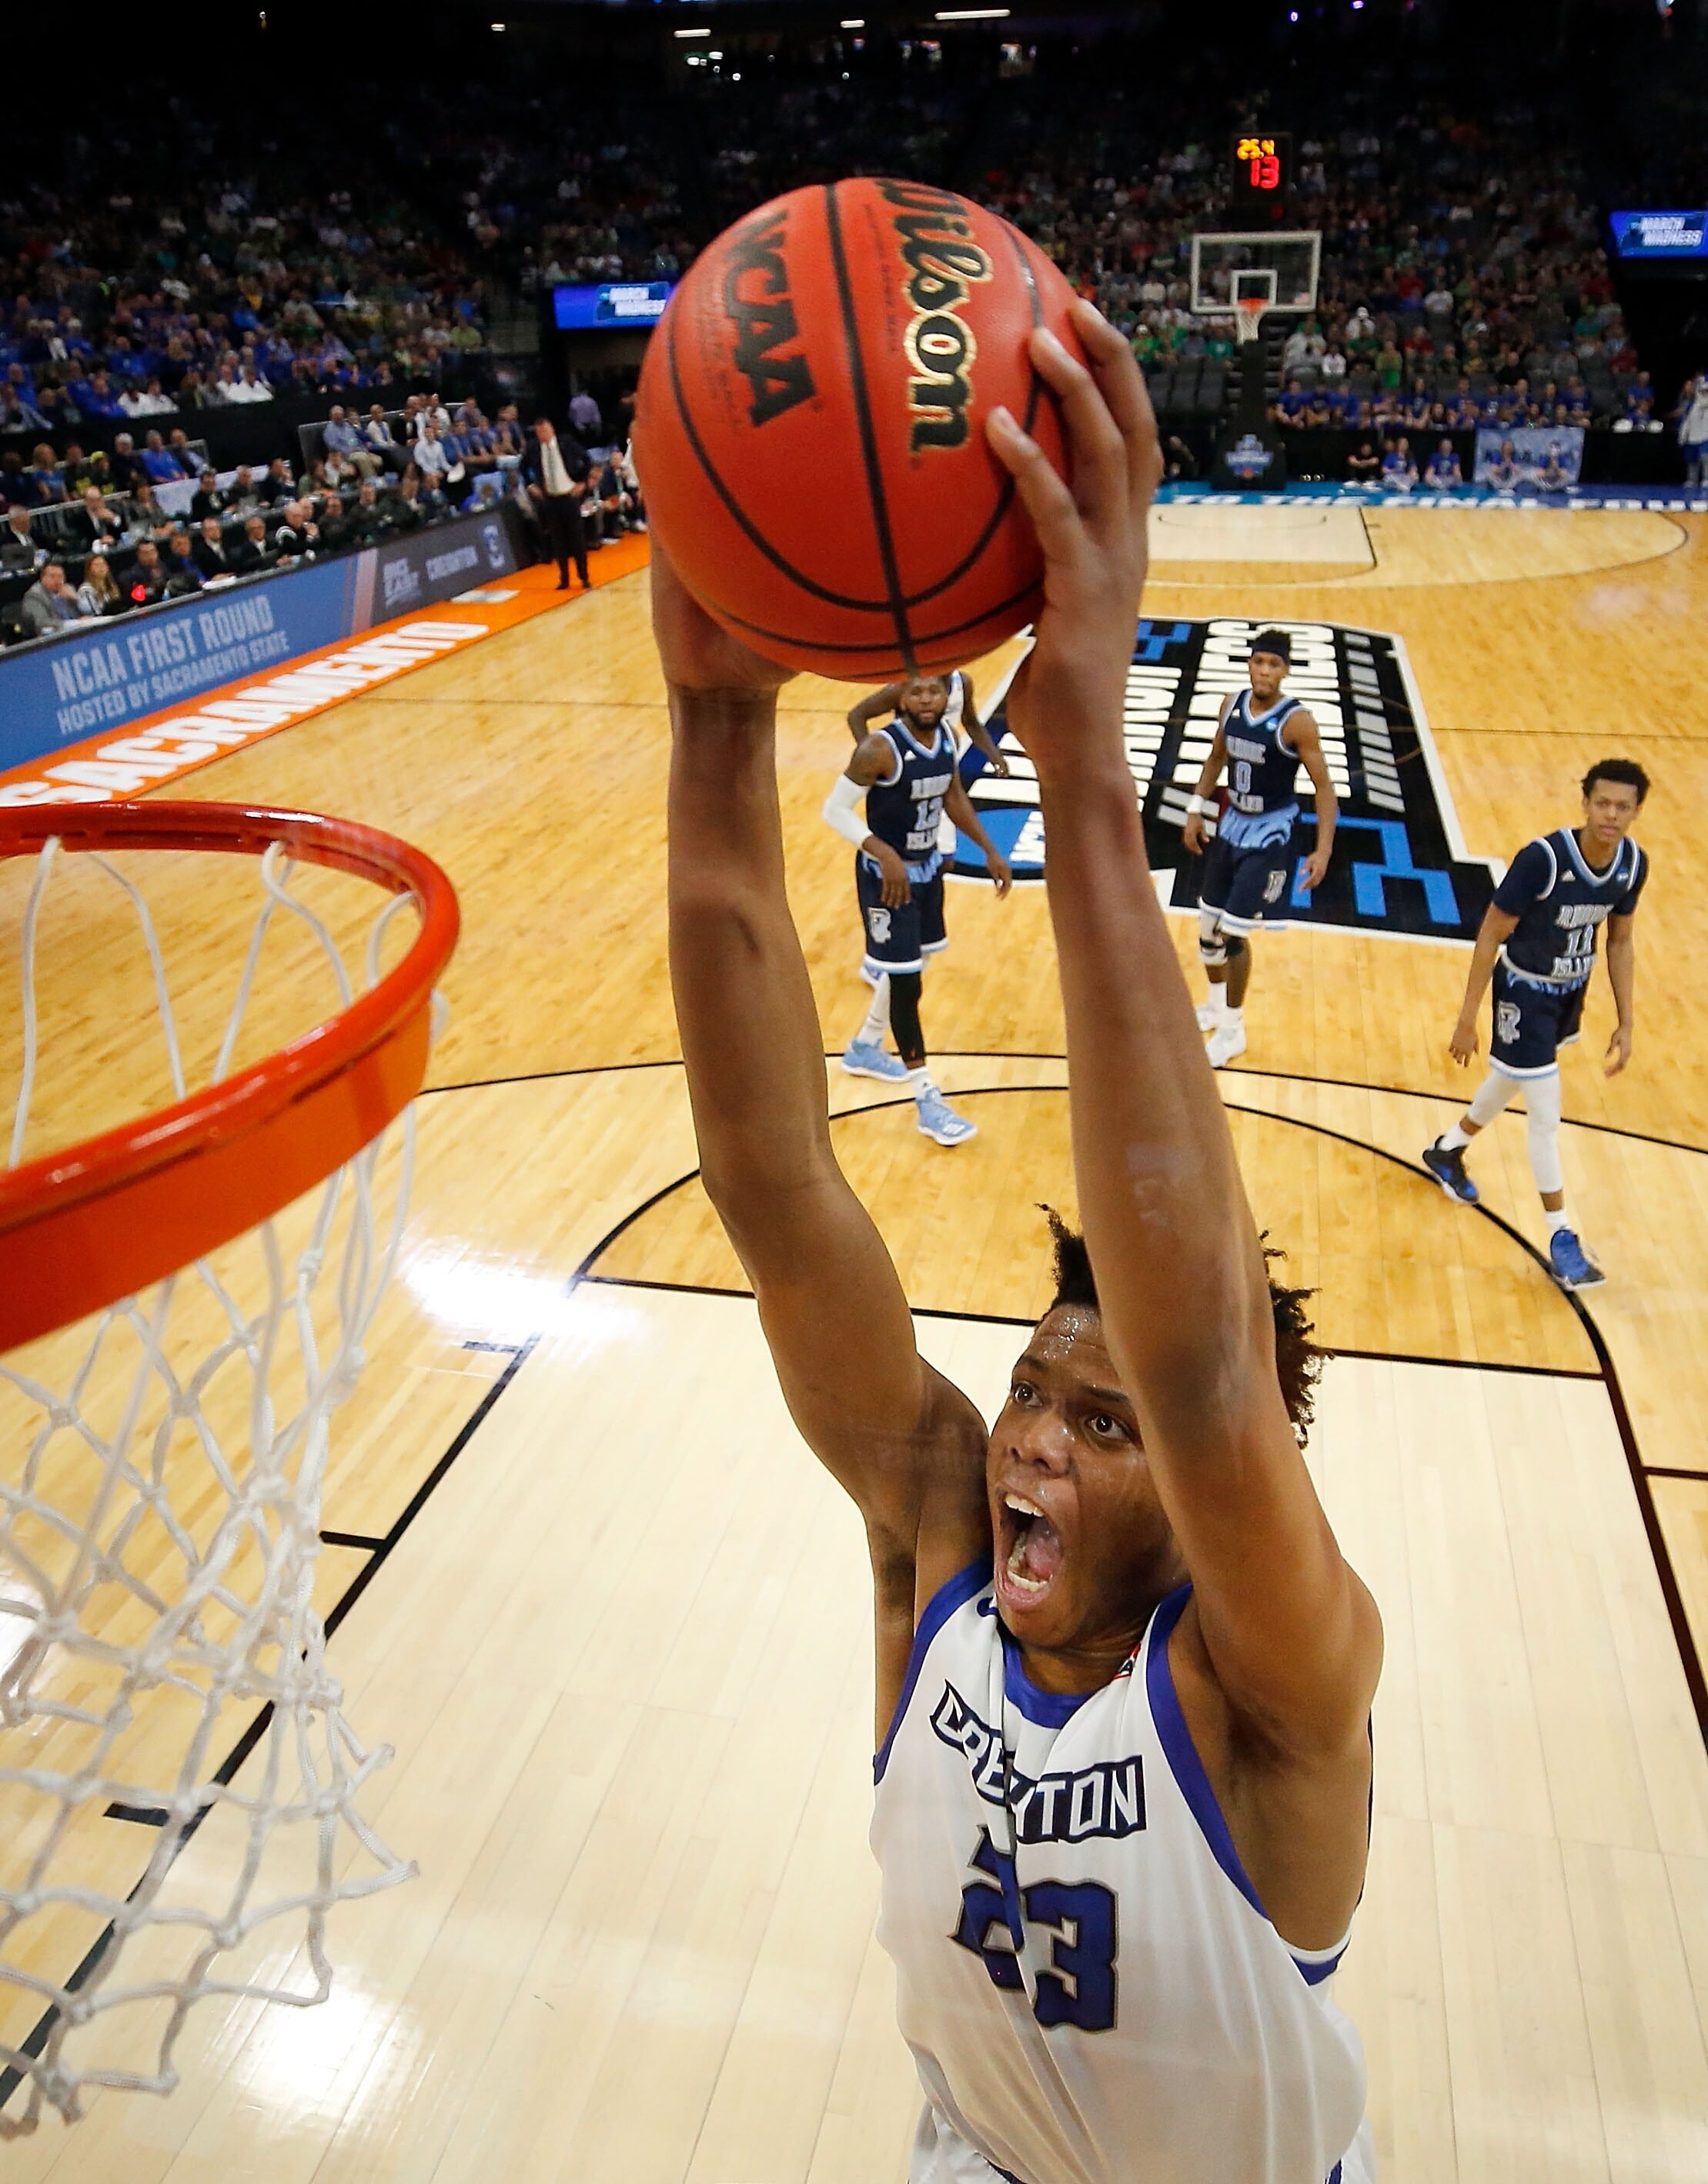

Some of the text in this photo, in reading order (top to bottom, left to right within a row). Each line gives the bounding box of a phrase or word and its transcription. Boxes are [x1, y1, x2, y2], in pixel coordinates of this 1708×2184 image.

[1251, 156, 1279, 189] 13
[724, 209, 817, 426] NCAA
[51, 594, 274, 702] NCAA FIRST ROUND
[56, 630, 290, 735] HOSTED BY SACRAMENTO STATE
[0, 620, 490, 808] SACRAMENTO
